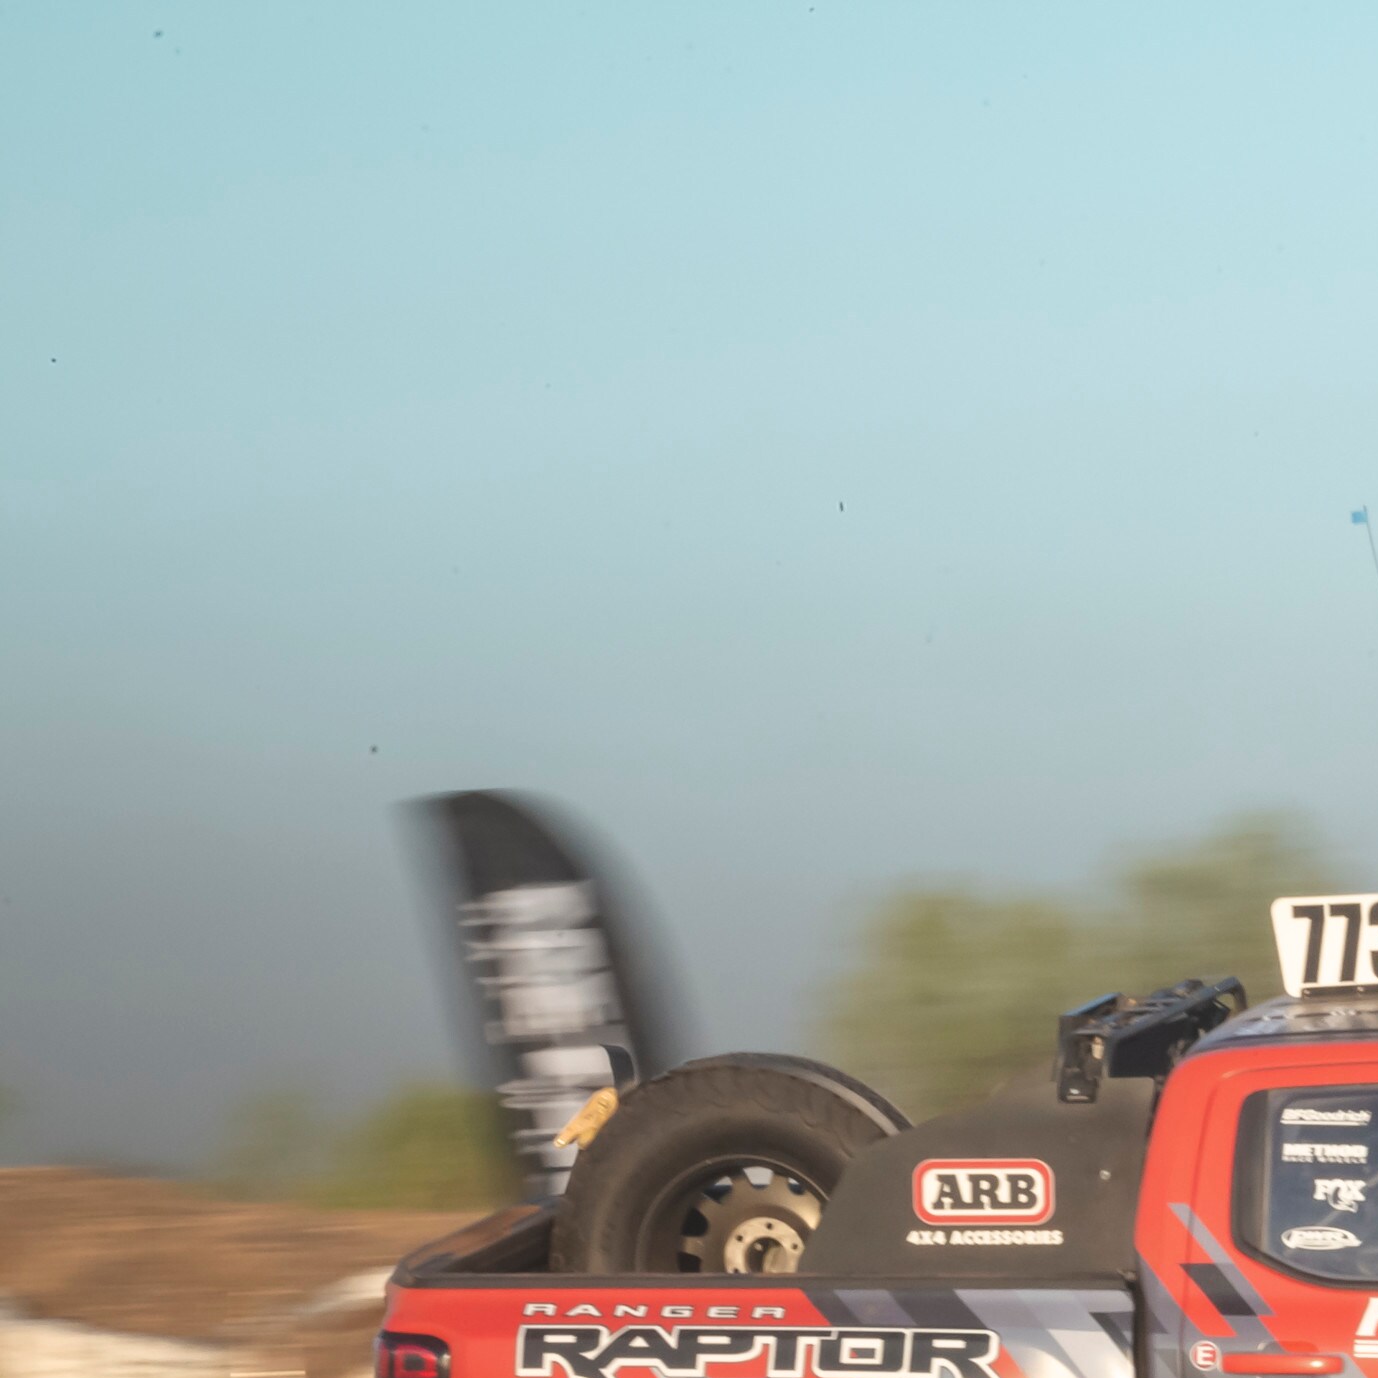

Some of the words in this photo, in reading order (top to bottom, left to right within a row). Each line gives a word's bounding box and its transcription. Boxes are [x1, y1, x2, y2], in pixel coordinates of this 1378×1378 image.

[932, 1173, 1037, 1209] ARB
[949, 1230, 1064, 1245] ACCESSORIES
[523, 1303, 785, 1319] RANGER
